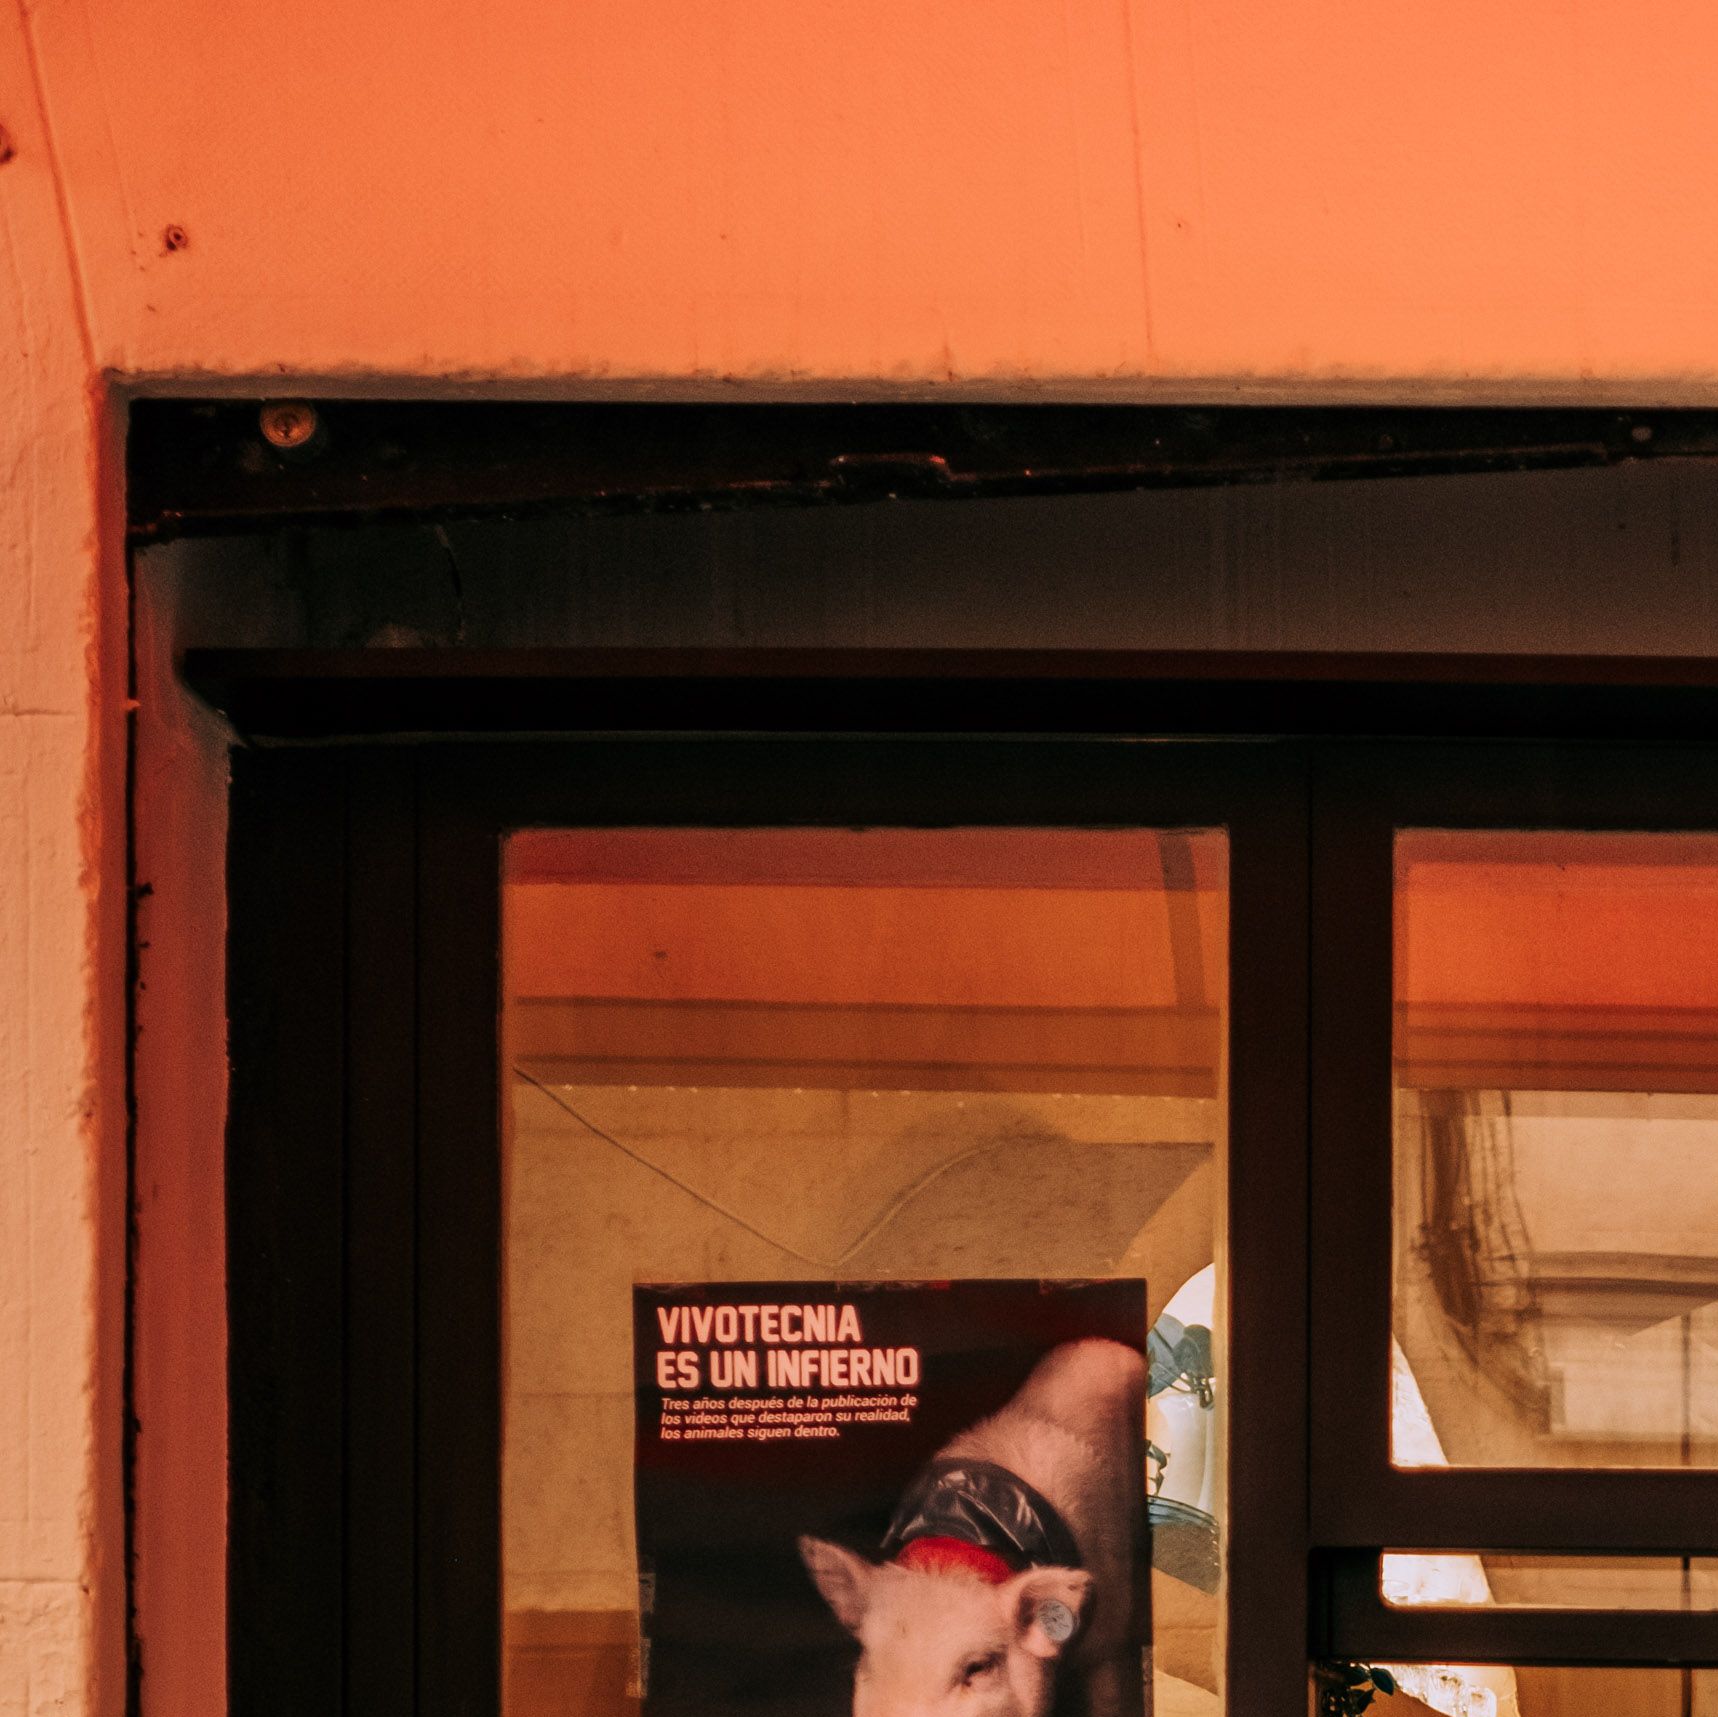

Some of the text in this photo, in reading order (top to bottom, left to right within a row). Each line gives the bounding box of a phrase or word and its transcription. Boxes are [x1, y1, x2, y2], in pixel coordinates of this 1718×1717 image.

[657, 1305, 861, 1343] VIVOTECNIA
[657, 1348, 918, 1388] ES UN INFIERNO
[661, 1394, 917, 1412] Tres años después de la publicación de
[661, 1414, 681, 1425] los
[730, 1414, 756, 1428] que
[758, 1411, 832, 1426] destaparon
[835, 1412, 852, 1422] su
[854, 1409, 911, 1423] realidad,
[661, 1425, 840, 1440] los animales siguen dentro.
